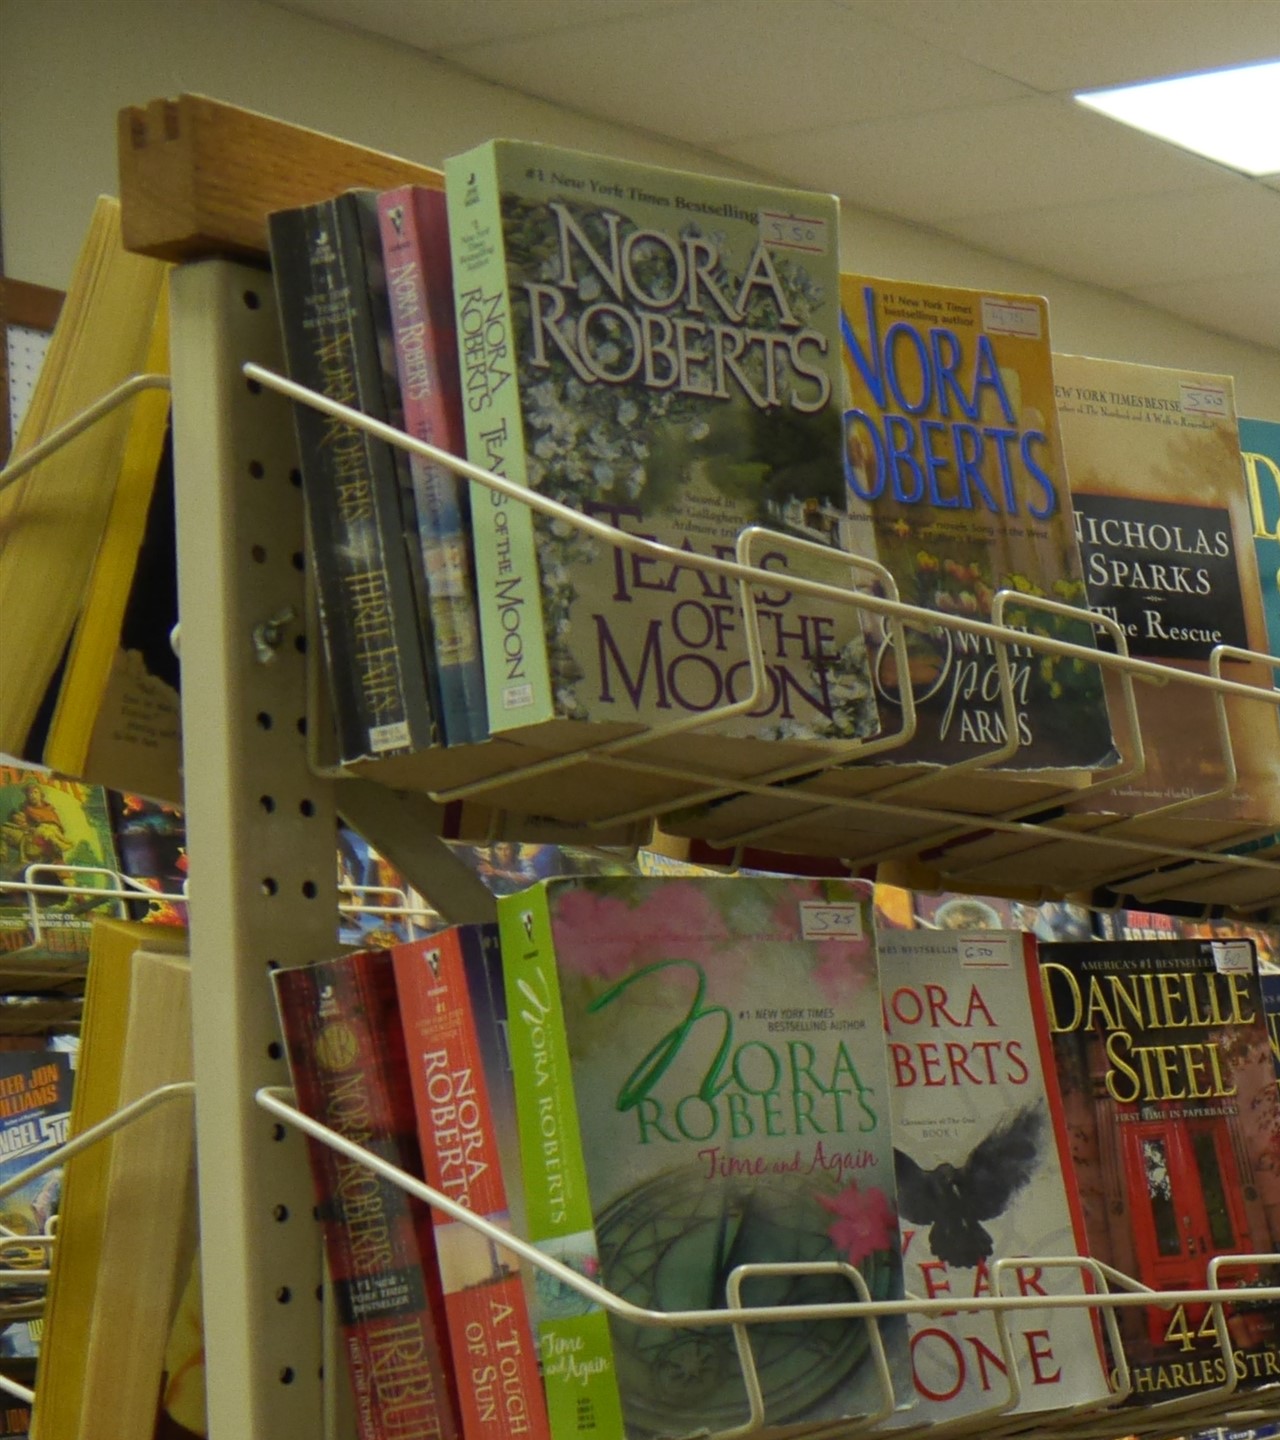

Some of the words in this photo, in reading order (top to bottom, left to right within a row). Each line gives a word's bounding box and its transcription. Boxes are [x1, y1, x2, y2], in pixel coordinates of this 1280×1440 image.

[550, 171, 584, 189] New
[587, 178, 624, 197] York
[629, 185, 669, 207] Times
[675, 195, 759, 226] Bestselling
[550, 203, 800, 327] NORA
[884, 307, 938, 324] bestselling
[942, 315, 973, 326] author
[923, 300, 942, 310] York
[460, 287, 493, 414] ROBERTS
[480, 289, 514, 393] NORA
[524, 282, 831, 413] ROBERTS
[1076, 389, 1105, 402] YORK
[1111, 392, 1143, 407] TIMES
[1072, 509, 1231, 558] NICHOLAS
[1089, 553, 1213, 596] SPARKS
[495, 577, 525, 680] MOON
[672, 600, 734, 650] OF
[1146, 609, 1223, 644] Rescue
[592, 613, 833, 719] MOON
[1080, 958, 1137, 971] AMERICA'S
[755, 1009, 778, 1021] NEW
[780, 1008, 805, 1020] YORK
[808, 1008, 835, 1019] TIMES
[1040, 962, 1257, 1034] DANIELLE
[586, 958, 868, 1112] NORA
[768, 1020, 828, 1033] BESTSELLING
[829, 1019, 866, 1032] AUTHOR
[1104, 1031, 1238, 1104] STEEL
[452, 1068, 485, 1185] NORA
[636, 1086, 878, 1146] ROBERTS
[922, 1127, 949, 1139] BOOK
[1115, 1111, 1142, 1123] FIRST
[1144, 1110, 1168, 1121] TIME
[1183, 1106, 1238, 1119] PAPERBACK!
[536, 1096, 567, 1225] ROBERTS
[698, 1146, 769, 1182] Time
[773, 1157, 801, 1174] and
[805, 1140, 879, 1184] Again
[465, 1322, 487, 1357] OF
[541, 1332, 585, 1351] Time
[1164, 1305, 1221, 1352] 44
[496, 1330, 528, 1435] TOUCH
[910, 1328, 1062, 1402] ONE
[472, 1365, 498, 1424] SUN
